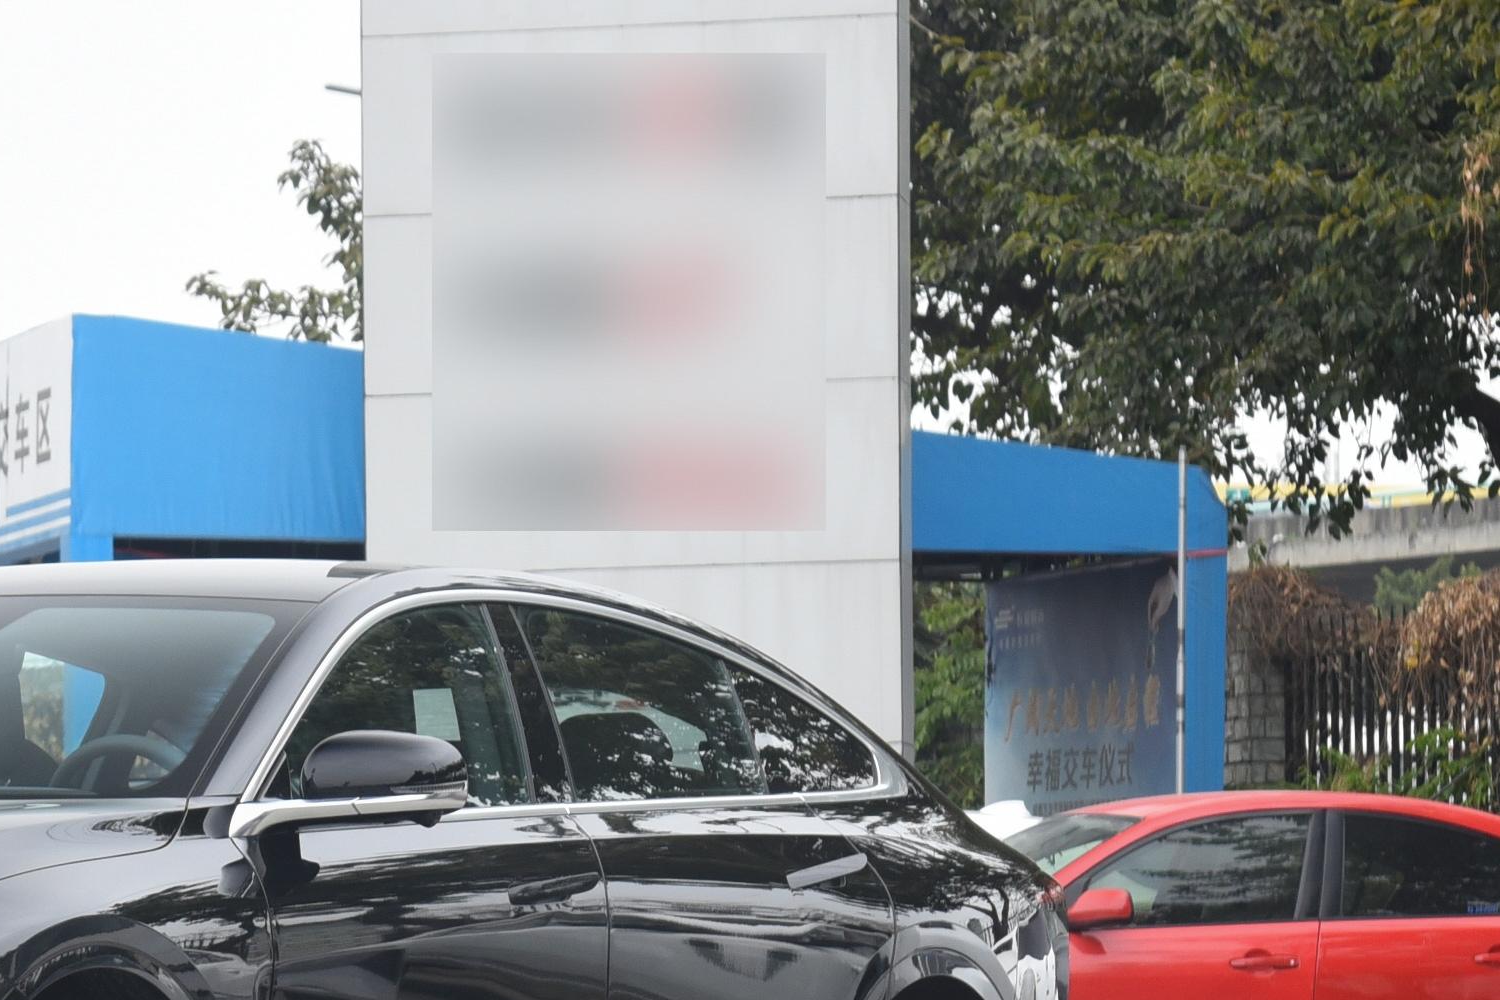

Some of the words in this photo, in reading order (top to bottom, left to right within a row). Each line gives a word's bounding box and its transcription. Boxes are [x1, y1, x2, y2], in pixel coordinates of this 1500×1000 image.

[1027, 743, 1135, 792] 幸福交车仪式
